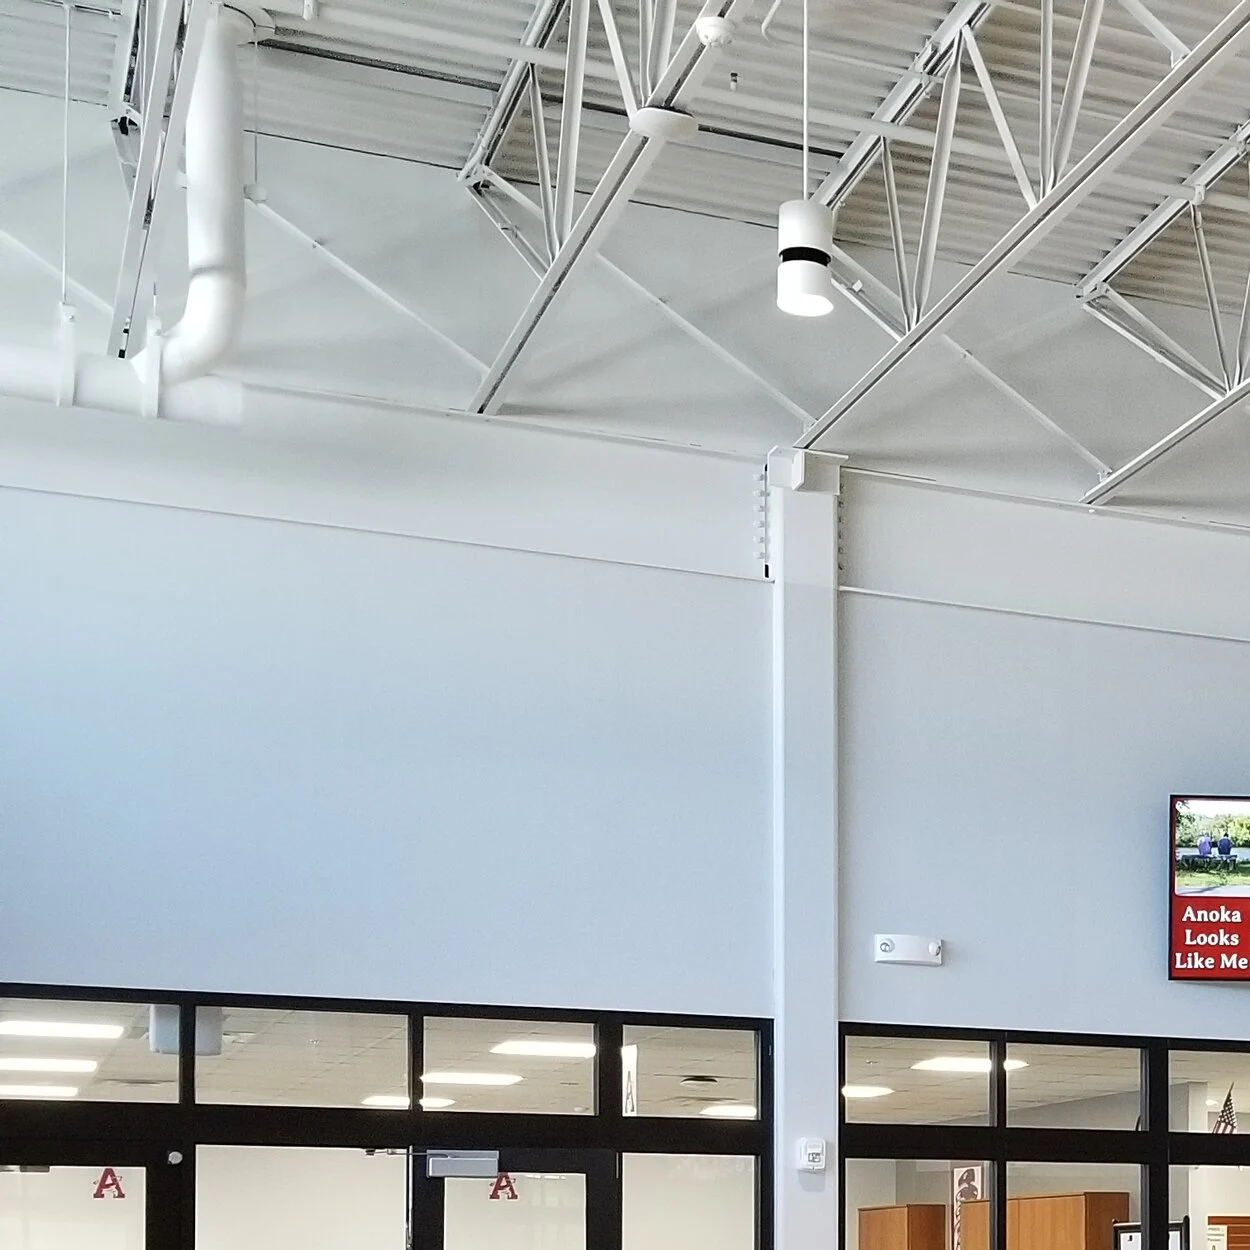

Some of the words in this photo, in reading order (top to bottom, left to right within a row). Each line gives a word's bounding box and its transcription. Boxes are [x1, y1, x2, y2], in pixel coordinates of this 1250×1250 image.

[1182, 905, 1242, 922] Anoka
[1185, 929, 1240, 946] Looks
[1175, 952, 1215, 969] Like
[1220, 953, 1249, 969] Me
[625, 1070, 635, 1114] A
[93, 1168, 126, 1199] A
[489, 1172, 519, 1200] A
